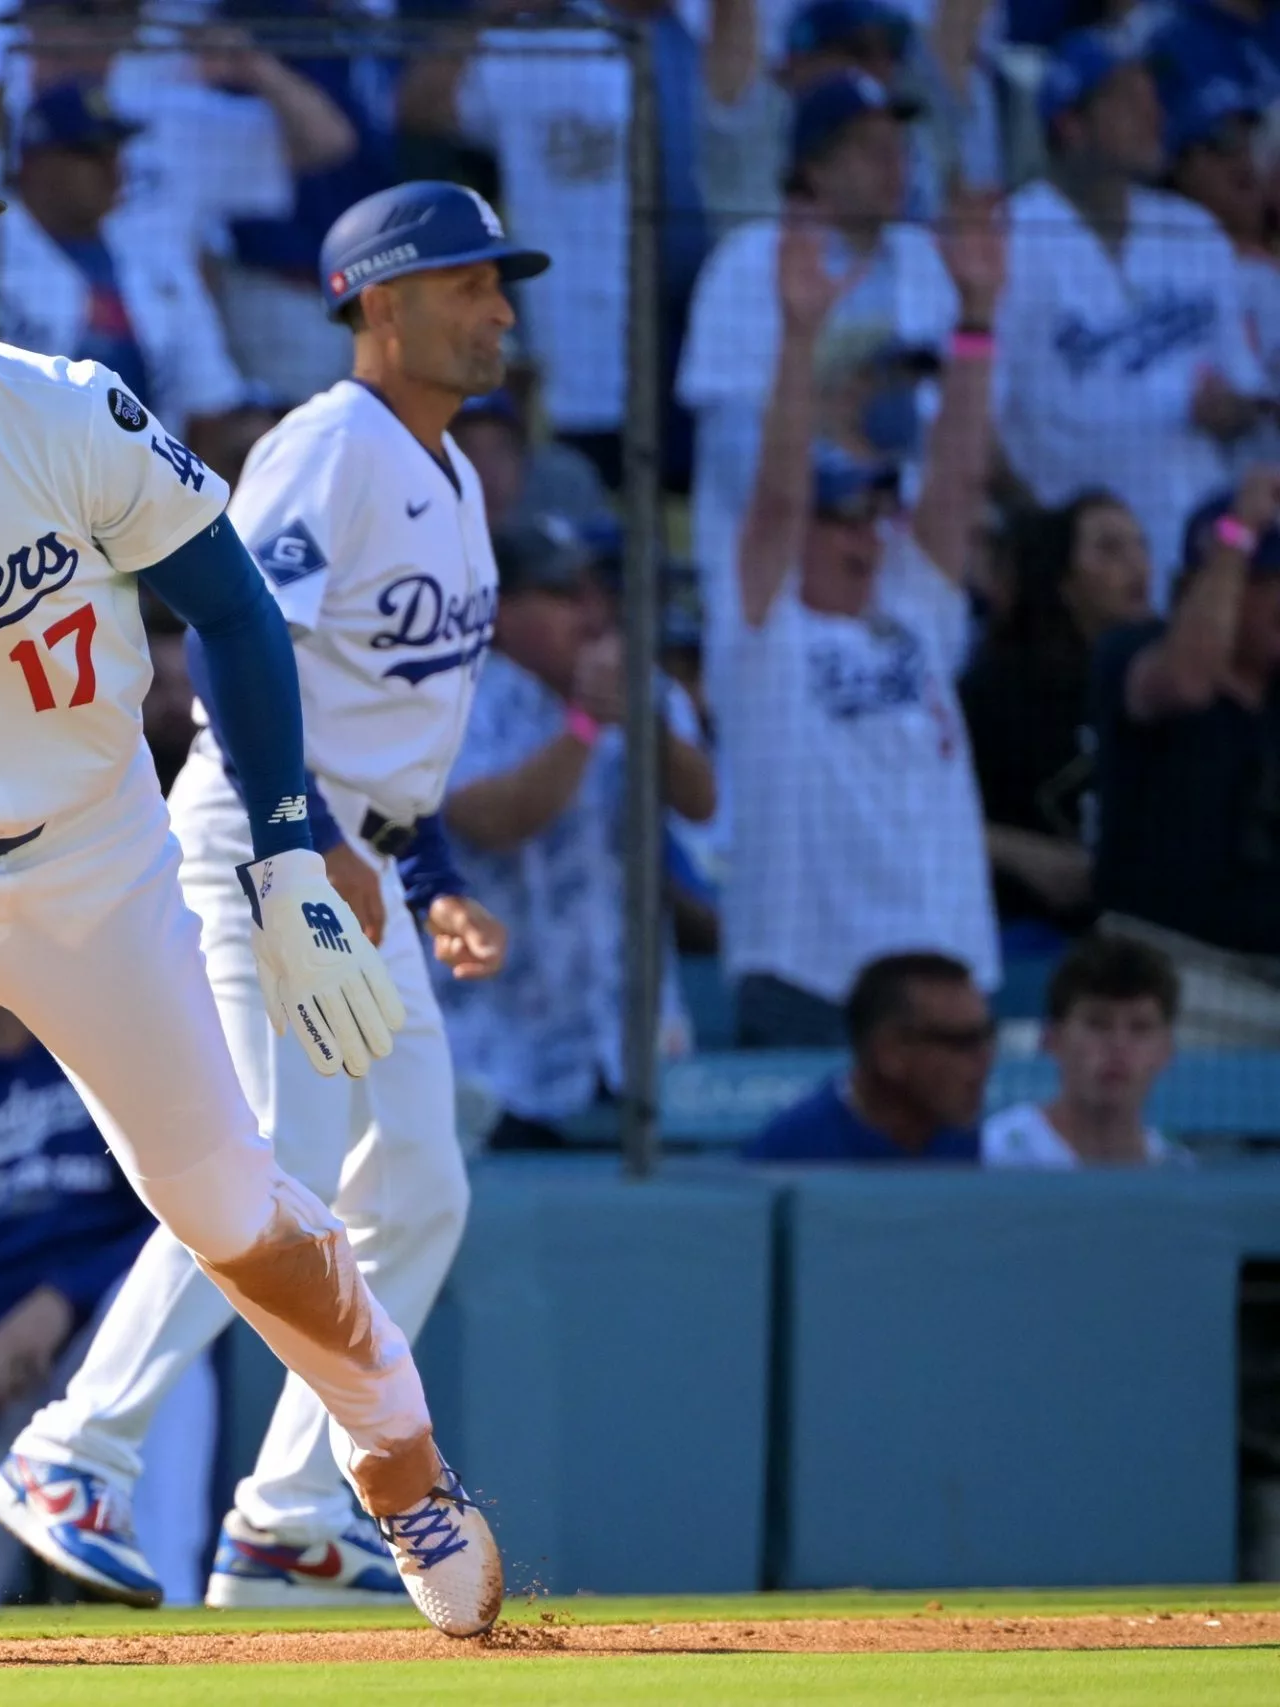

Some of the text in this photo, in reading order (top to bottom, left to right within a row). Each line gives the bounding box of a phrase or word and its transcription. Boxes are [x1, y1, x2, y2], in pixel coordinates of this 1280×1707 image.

[344, 242, 419, 286] STRAUSS
[151, 434, 205, 493] LA
[9, 602, 97, 712] 17
[297, 1003, 322, 1043] balance
